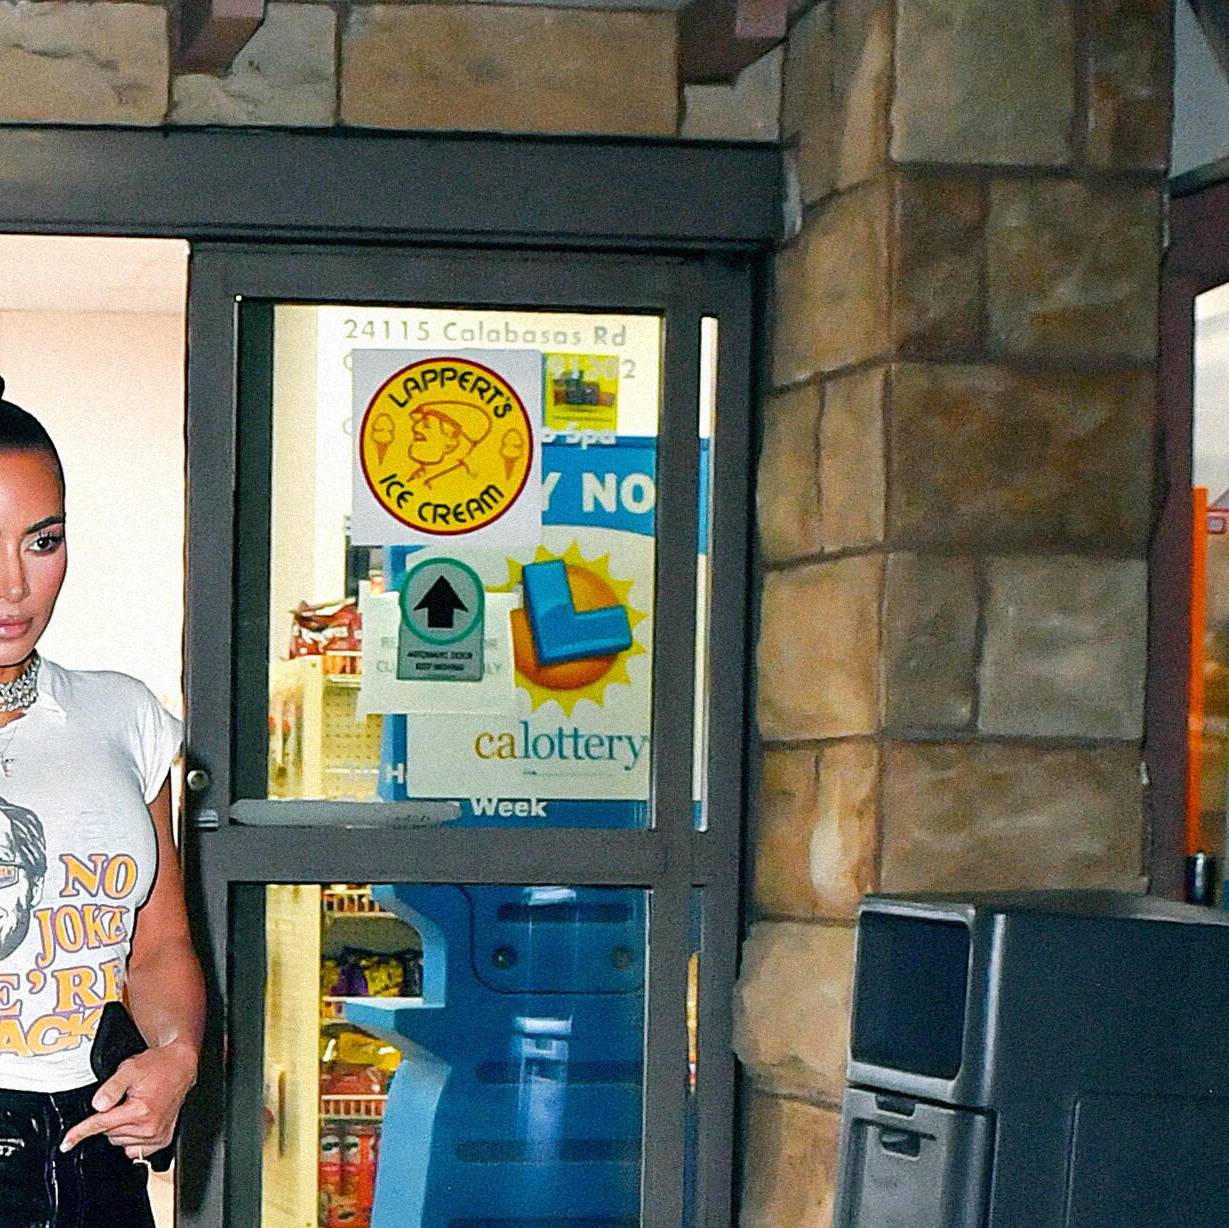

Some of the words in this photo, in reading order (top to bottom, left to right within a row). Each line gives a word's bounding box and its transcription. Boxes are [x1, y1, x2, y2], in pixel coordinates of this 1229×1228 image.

[343, 318, 430, 341] 24115
[442, 321, 582, 346] Calabasas
[594, 325, 626, 347] Rd
[388, 367, 513, 419] LAPPERT'S
[565, 421, 618, 450] Spa
[378, 473, 415, 510] ICE
[417, 484, 505, 525] CREAM
[474, 720, 650, 771] calottery
[471, 797, 548, 818] Week
[59, 853, 139, 900] NO
